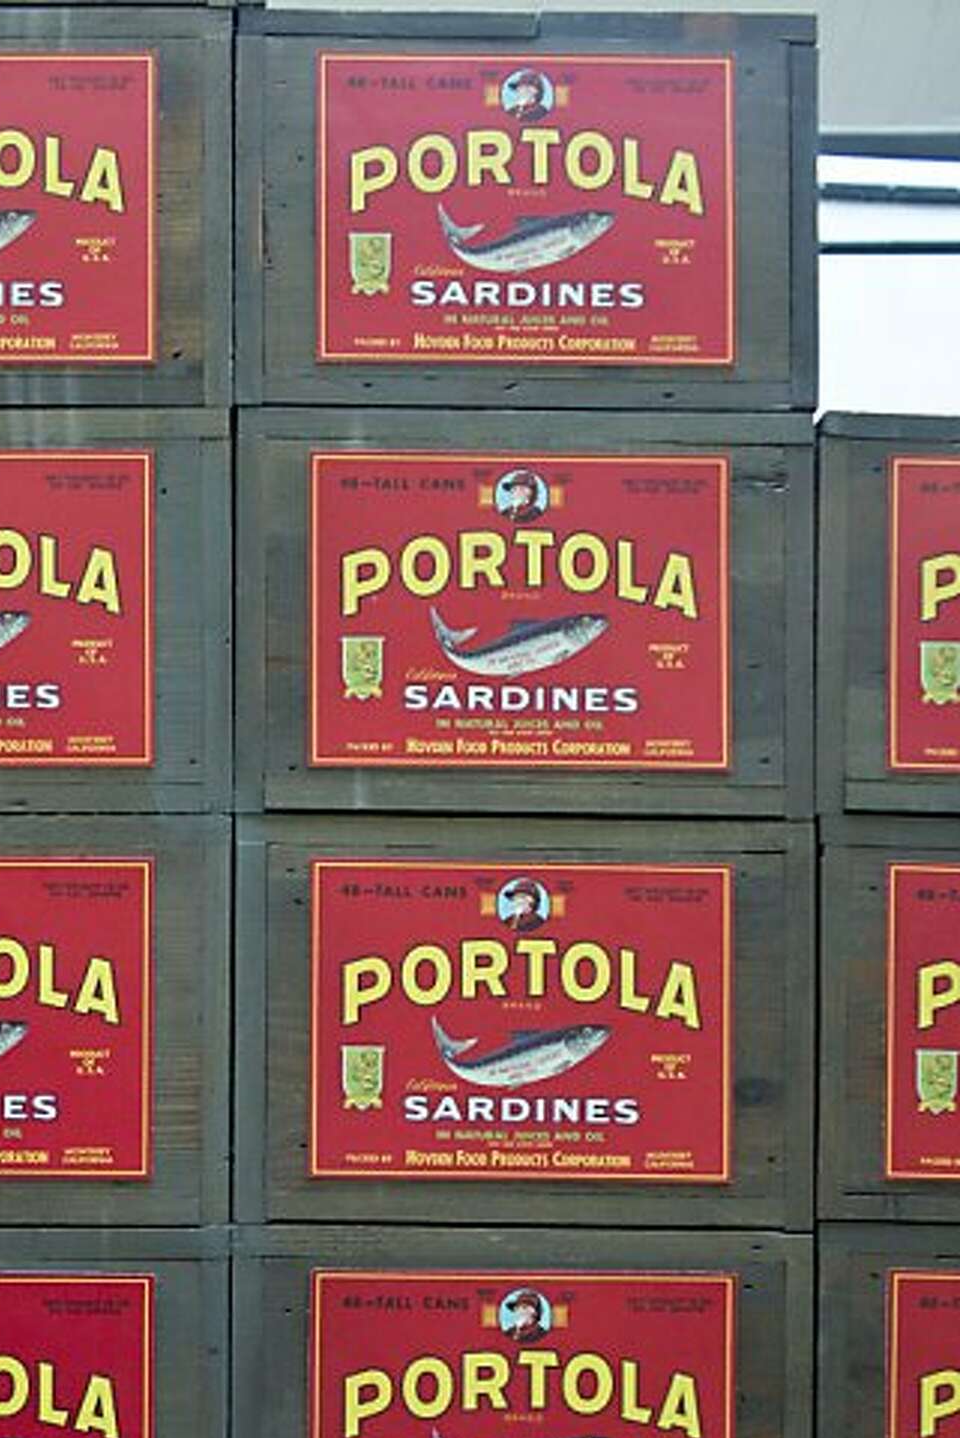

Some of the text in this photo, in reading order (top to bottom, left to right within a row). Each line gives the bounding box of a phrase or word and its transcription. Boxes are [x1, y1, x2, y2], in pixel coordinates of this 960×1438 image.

[350, 127, 706, 215] PORTOLA
[411, 280, 644, 307] SARDINES
[463, 334, 494, 349] FOOD
[342, 529, 700, 618] PORTOLA
[404, 684, 638, 712] SARDINES
[456, 738, 488, 754] FOOD
[491, 738, 548, 754] PRODUCTS
[552, 739, 630, 755] CORPORATION
[343, 938, 702, 1029] PORTOLA
[403, 1095, 639, 1123] SARDINES
[456, 1150, 488, 1166] FOOD
[491, 1150, 548, 1166] PRODUCTS
[552, 1150, 631, 1167] CORPORATION
